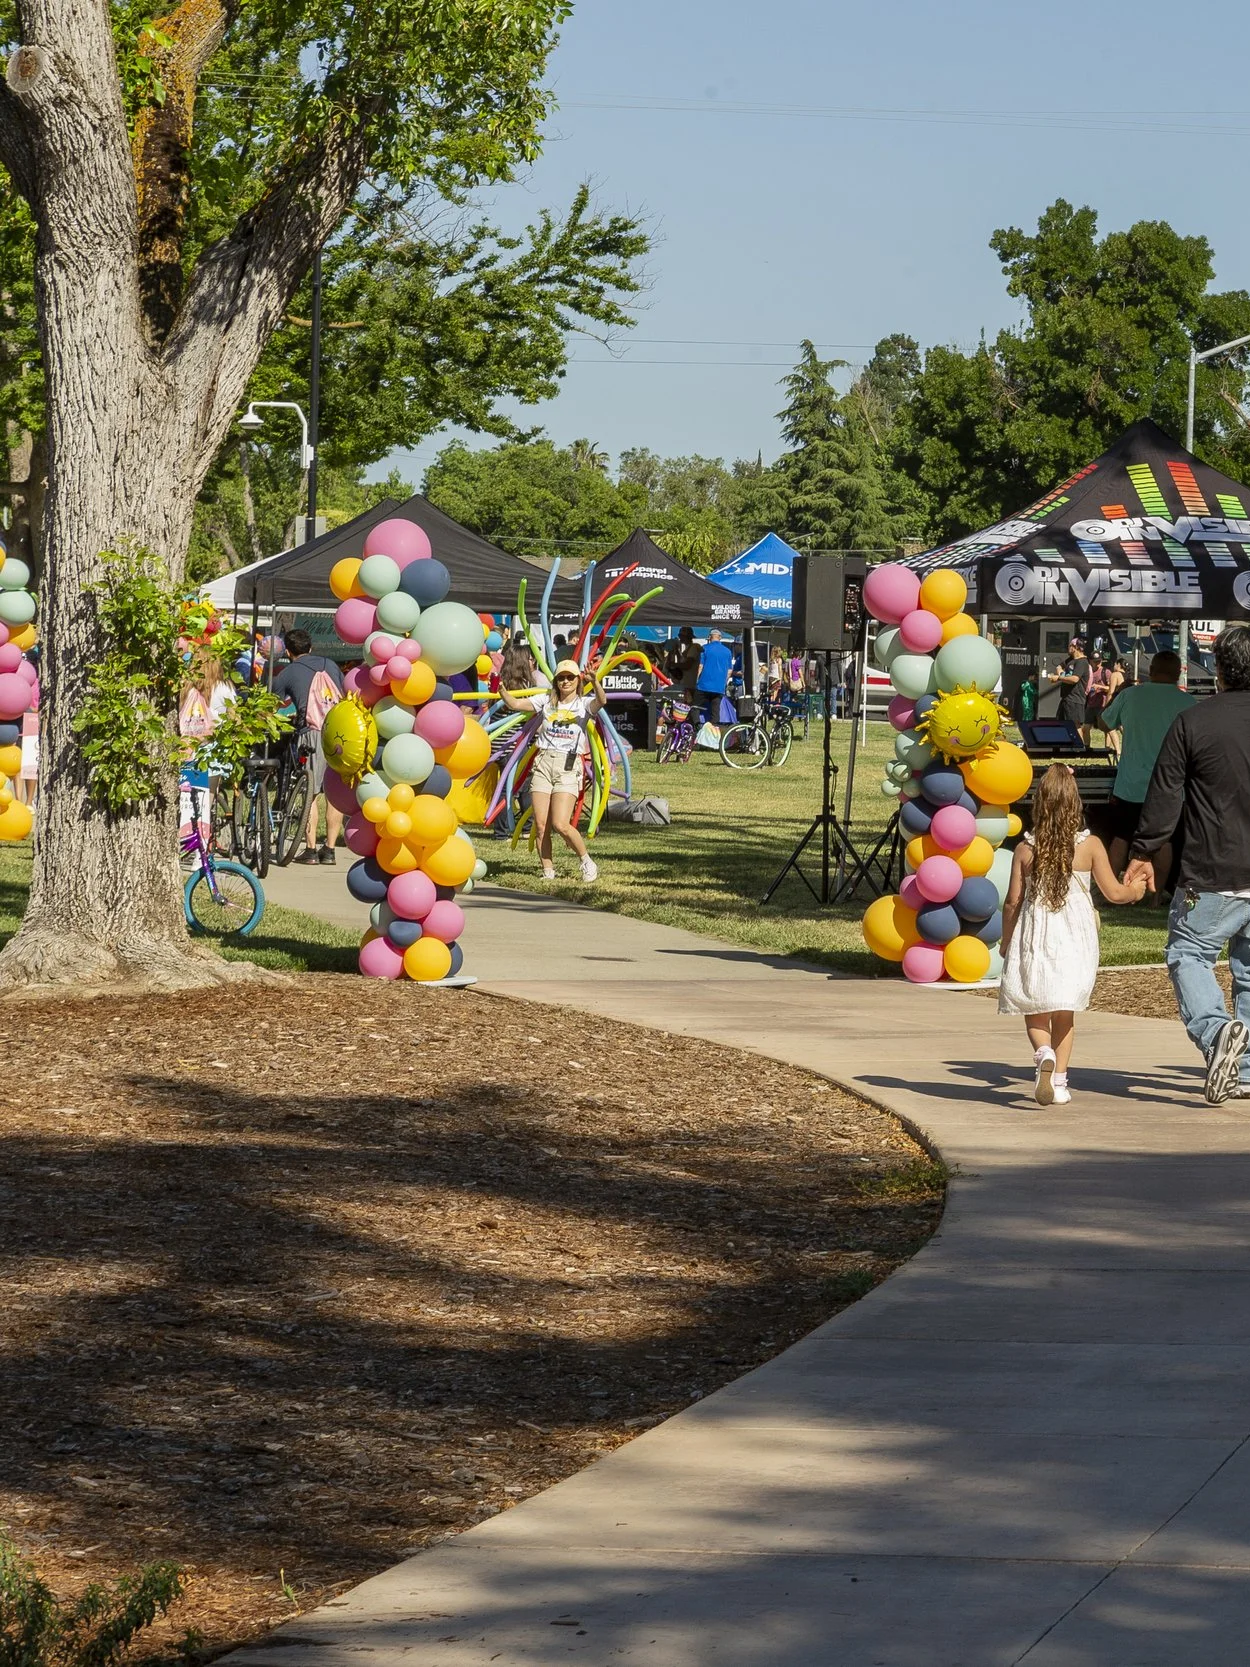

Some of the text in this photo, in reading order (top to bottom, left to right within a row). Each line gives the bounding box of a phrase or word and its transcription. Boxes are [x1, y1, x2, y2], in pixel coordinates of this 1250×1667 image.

[751, 562, 790, 575] MID
[1006, 653, 1031, 665] MODESTO
[615, 675, 638, 683] Little
[615, 681, 644, 691] Buddy
